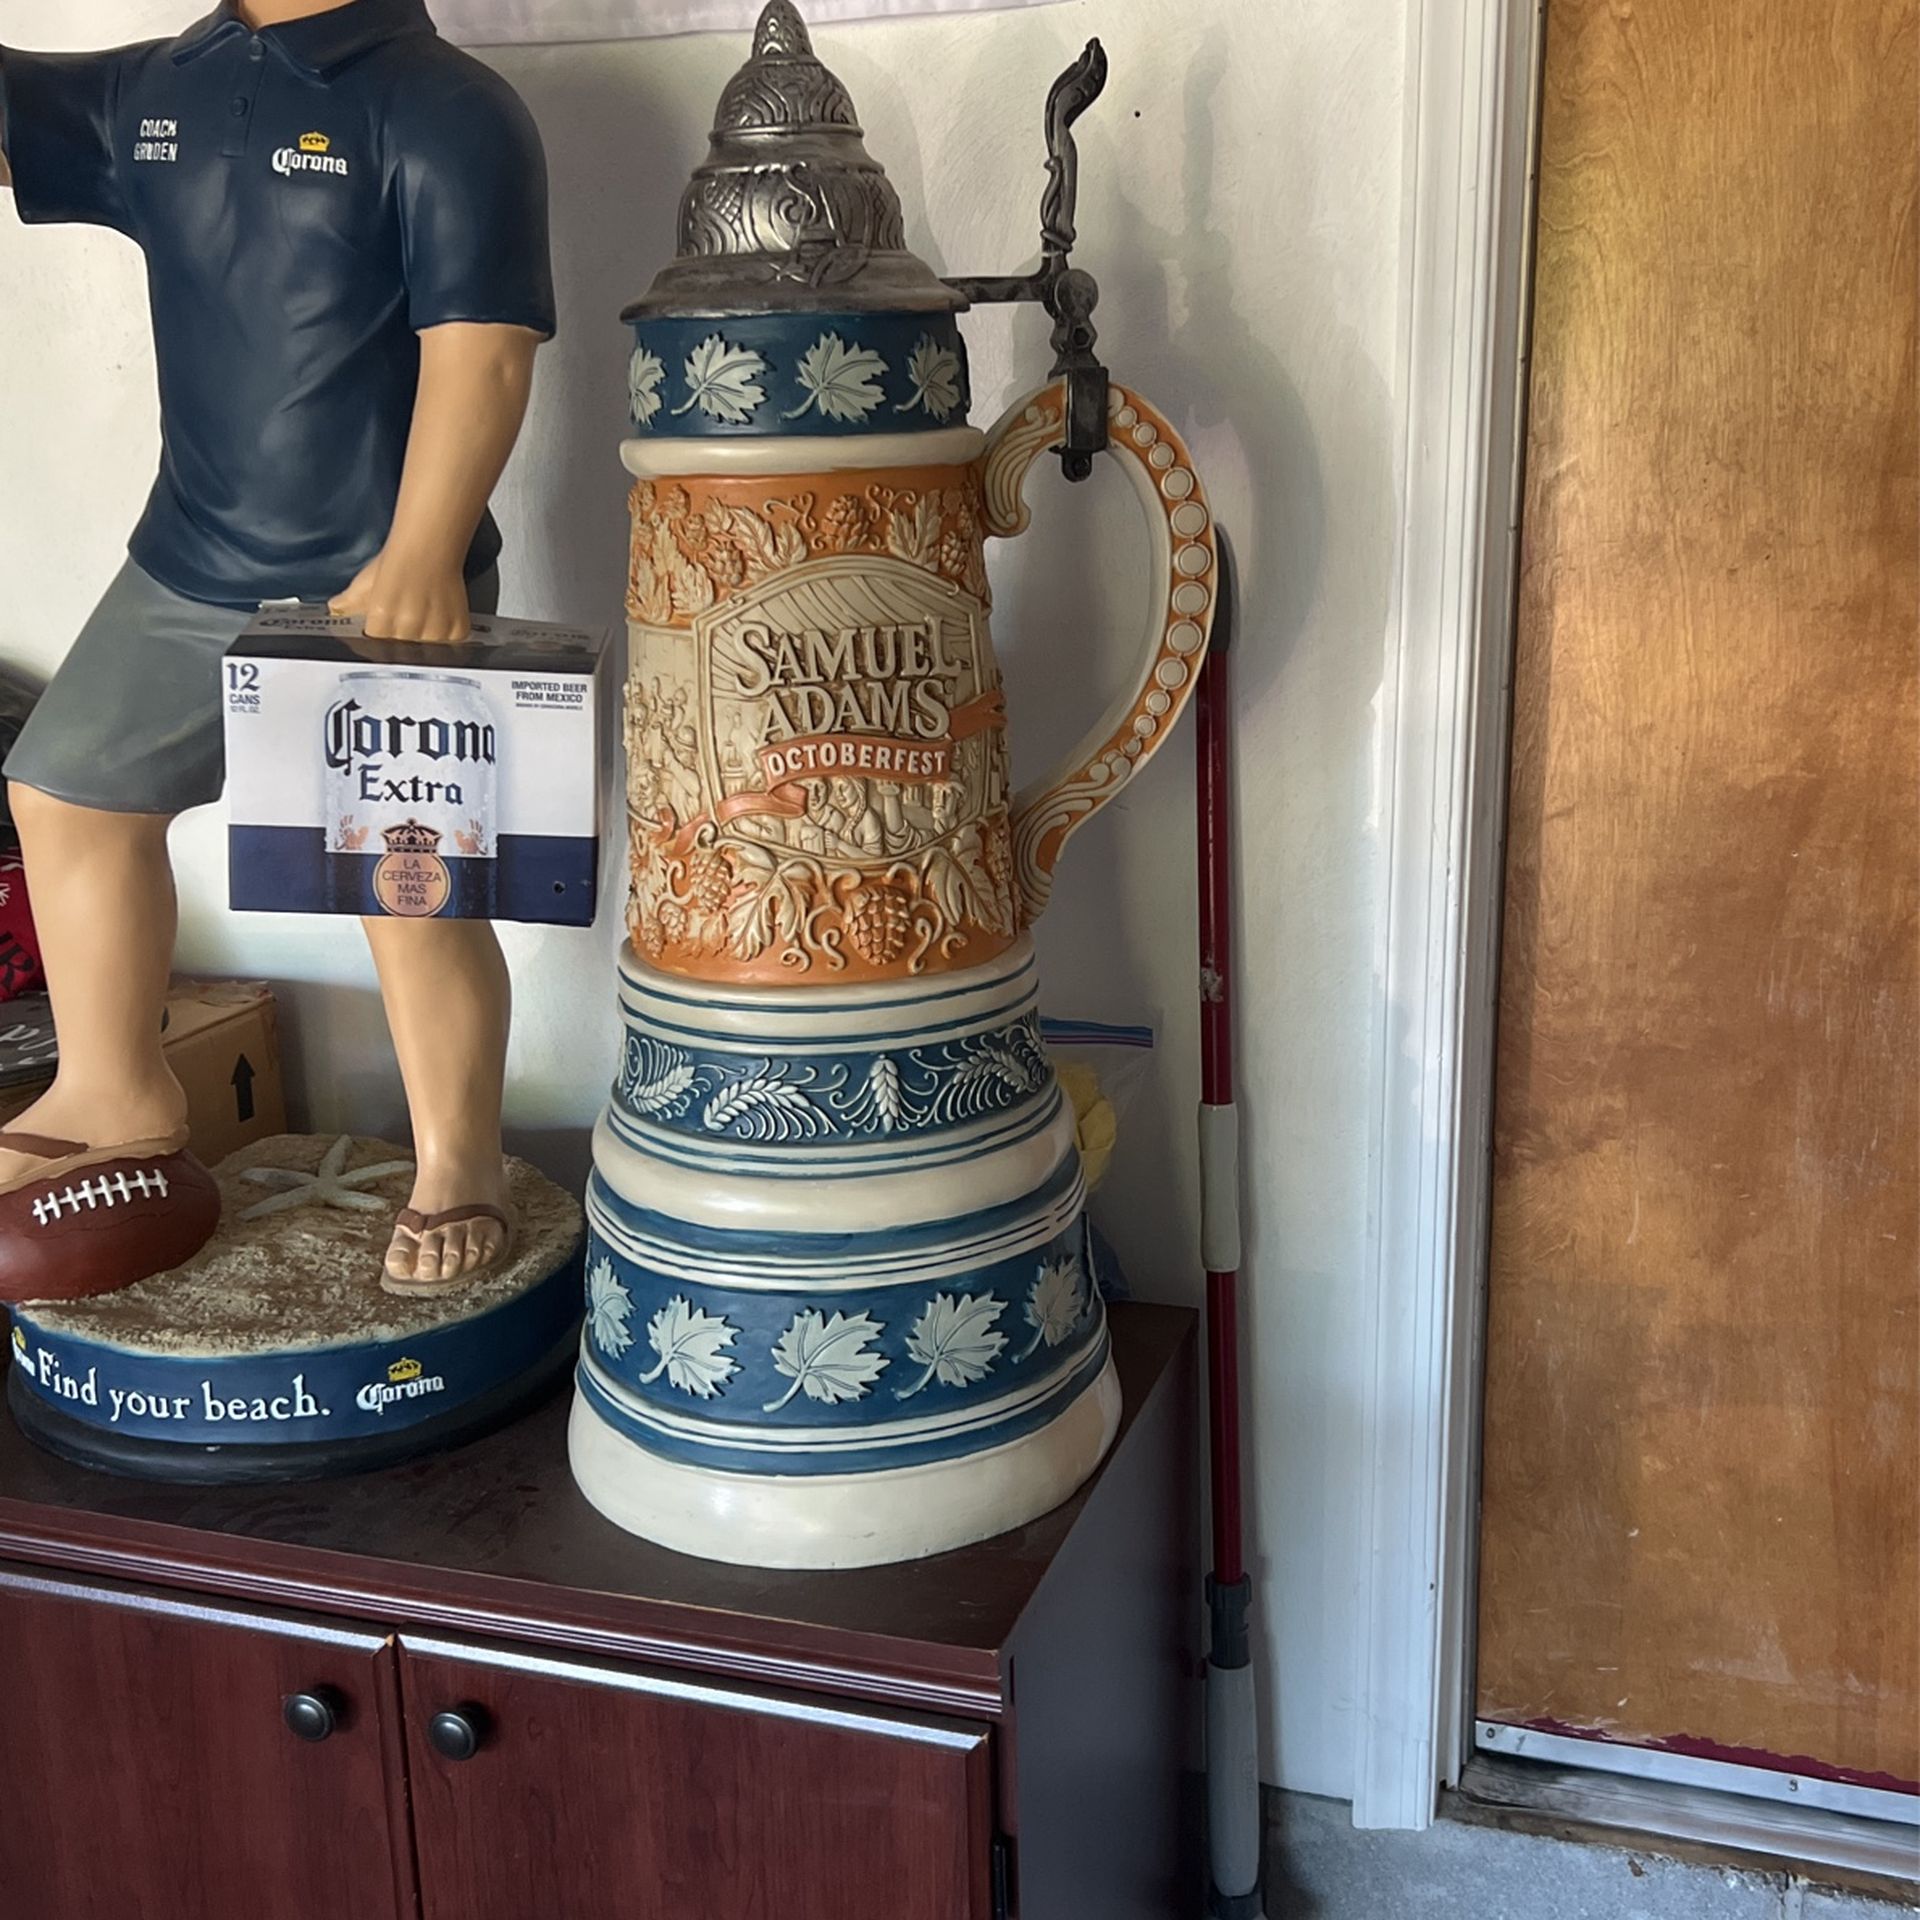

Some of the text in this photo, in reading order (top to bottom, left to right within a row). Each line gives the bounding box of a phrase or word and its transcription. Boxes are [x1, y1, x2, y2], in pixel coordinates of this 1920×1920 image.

[140, 118, 177, 138] COACH
[271, 147, 348, 177] Corona
[733, 613, 962, 698] SAMUEL
[227, 662, 260, 692] 12
[511, 680, 588, 693] IMPORTED BEER
[229, 693, 261, 705] CANS
[516, 690, 583, 703] FROM MEXICO
[755, 678, 951, 747] ADAMS
[324, 698, 496, 776] Corona
[767, 742, 946, 777] OCTOBERFEST
[357, 763, 464, 806] Extra
[382, 870, 442, 882] CERVEZA
[403, 859, 421, 869] LA
[397, 883, 427, 894] MAS
[397, 895, 427, 906] FINA
[37, 1347, 98, 1406] Find
[109, 1388, 191, 1422] your
[201, 1373, 331, 1421] beach.
[356, 1375, 445, 1416] Corona
